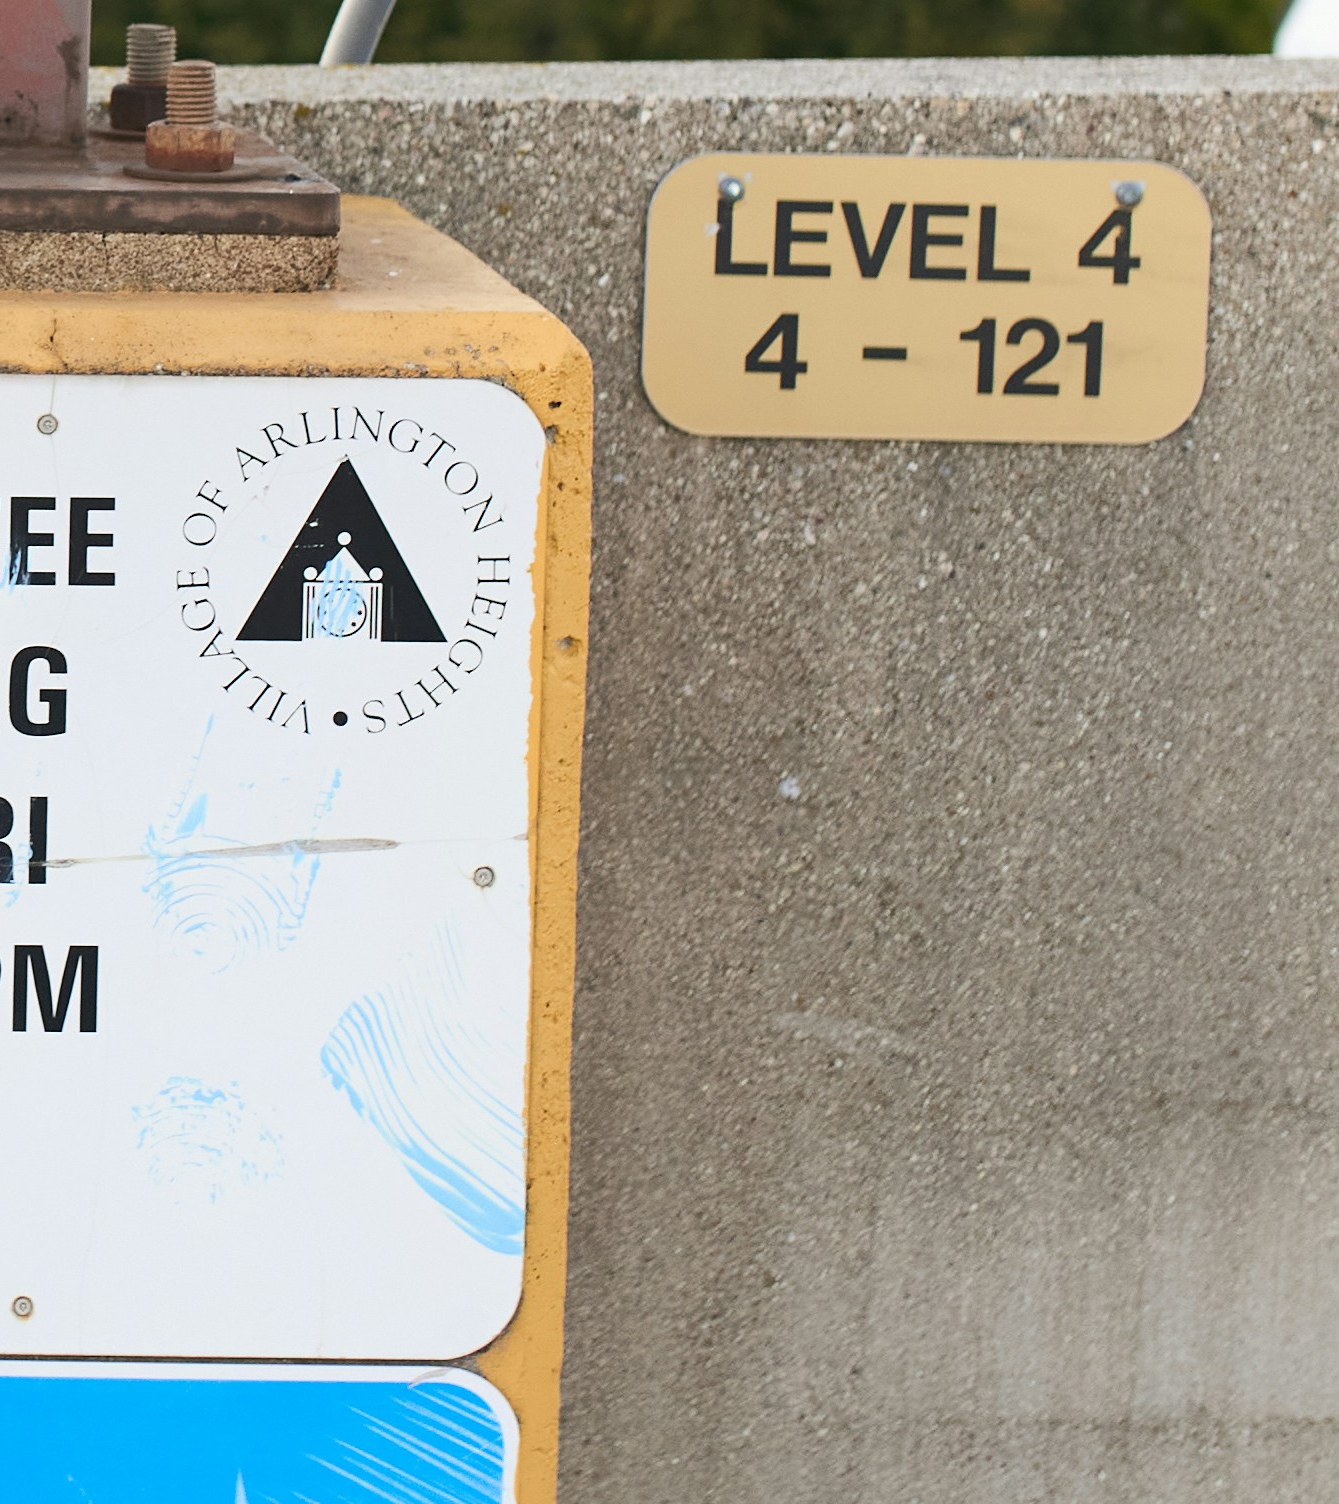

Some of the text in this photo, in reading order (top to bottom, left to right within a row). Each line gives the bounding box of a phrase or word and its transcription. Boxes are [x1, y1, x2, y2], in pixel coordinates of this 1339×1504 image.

[714, 198, 1141, 285] LEVEL 4
[744, 313, 808, 390] 4
[959, 317, 1103, 397] 121
[176, 406, 511, 735] VILLAGE OF ARLINGTON HEIGHTS
